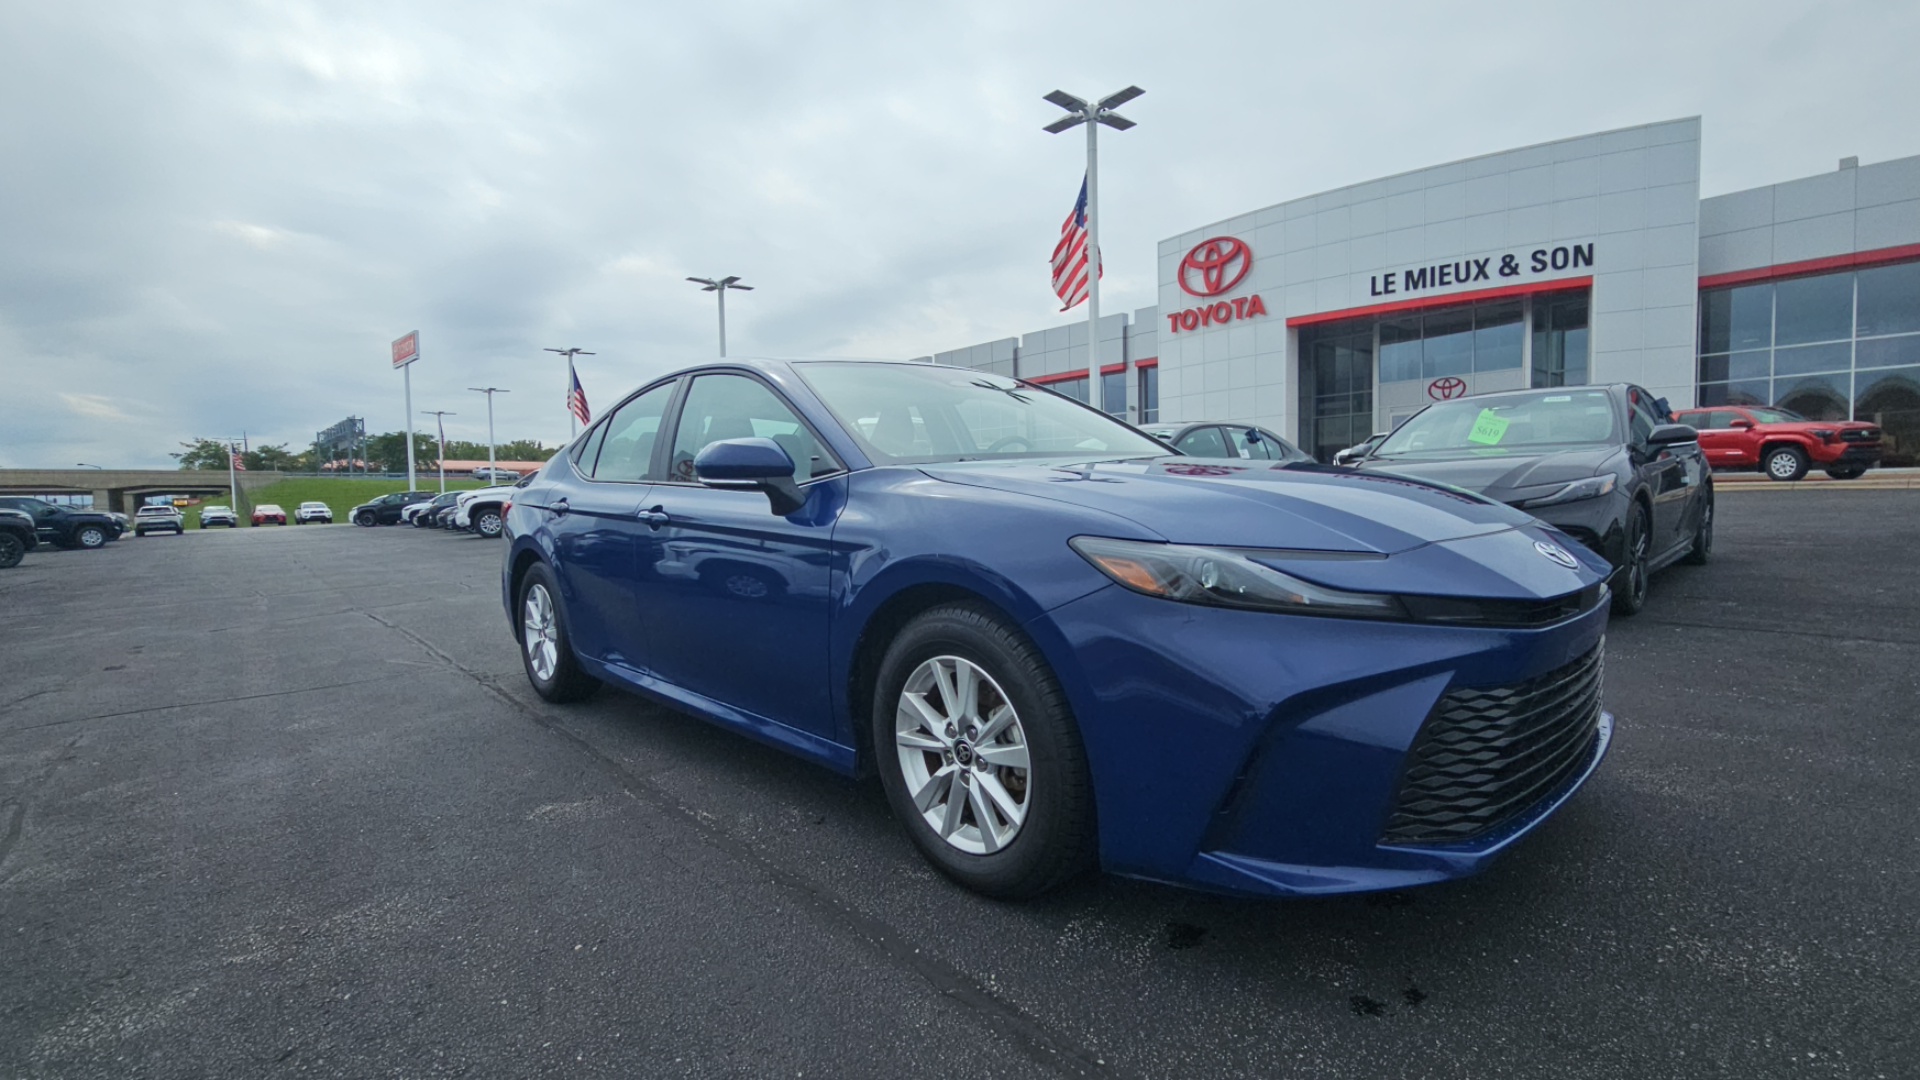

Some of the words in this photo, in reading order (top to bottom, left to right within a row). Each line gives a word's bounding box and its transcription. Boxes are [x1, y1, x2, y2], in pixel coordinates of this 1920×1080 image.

[1371, 272, 1397, 297] LE
[1404, 257, 1490, 291] MIEUX
[1499, 254, 1520, 277] &
[1531, 243, 1594, 273] SON
[1167, 294, 1267, 334] TOYOTA
